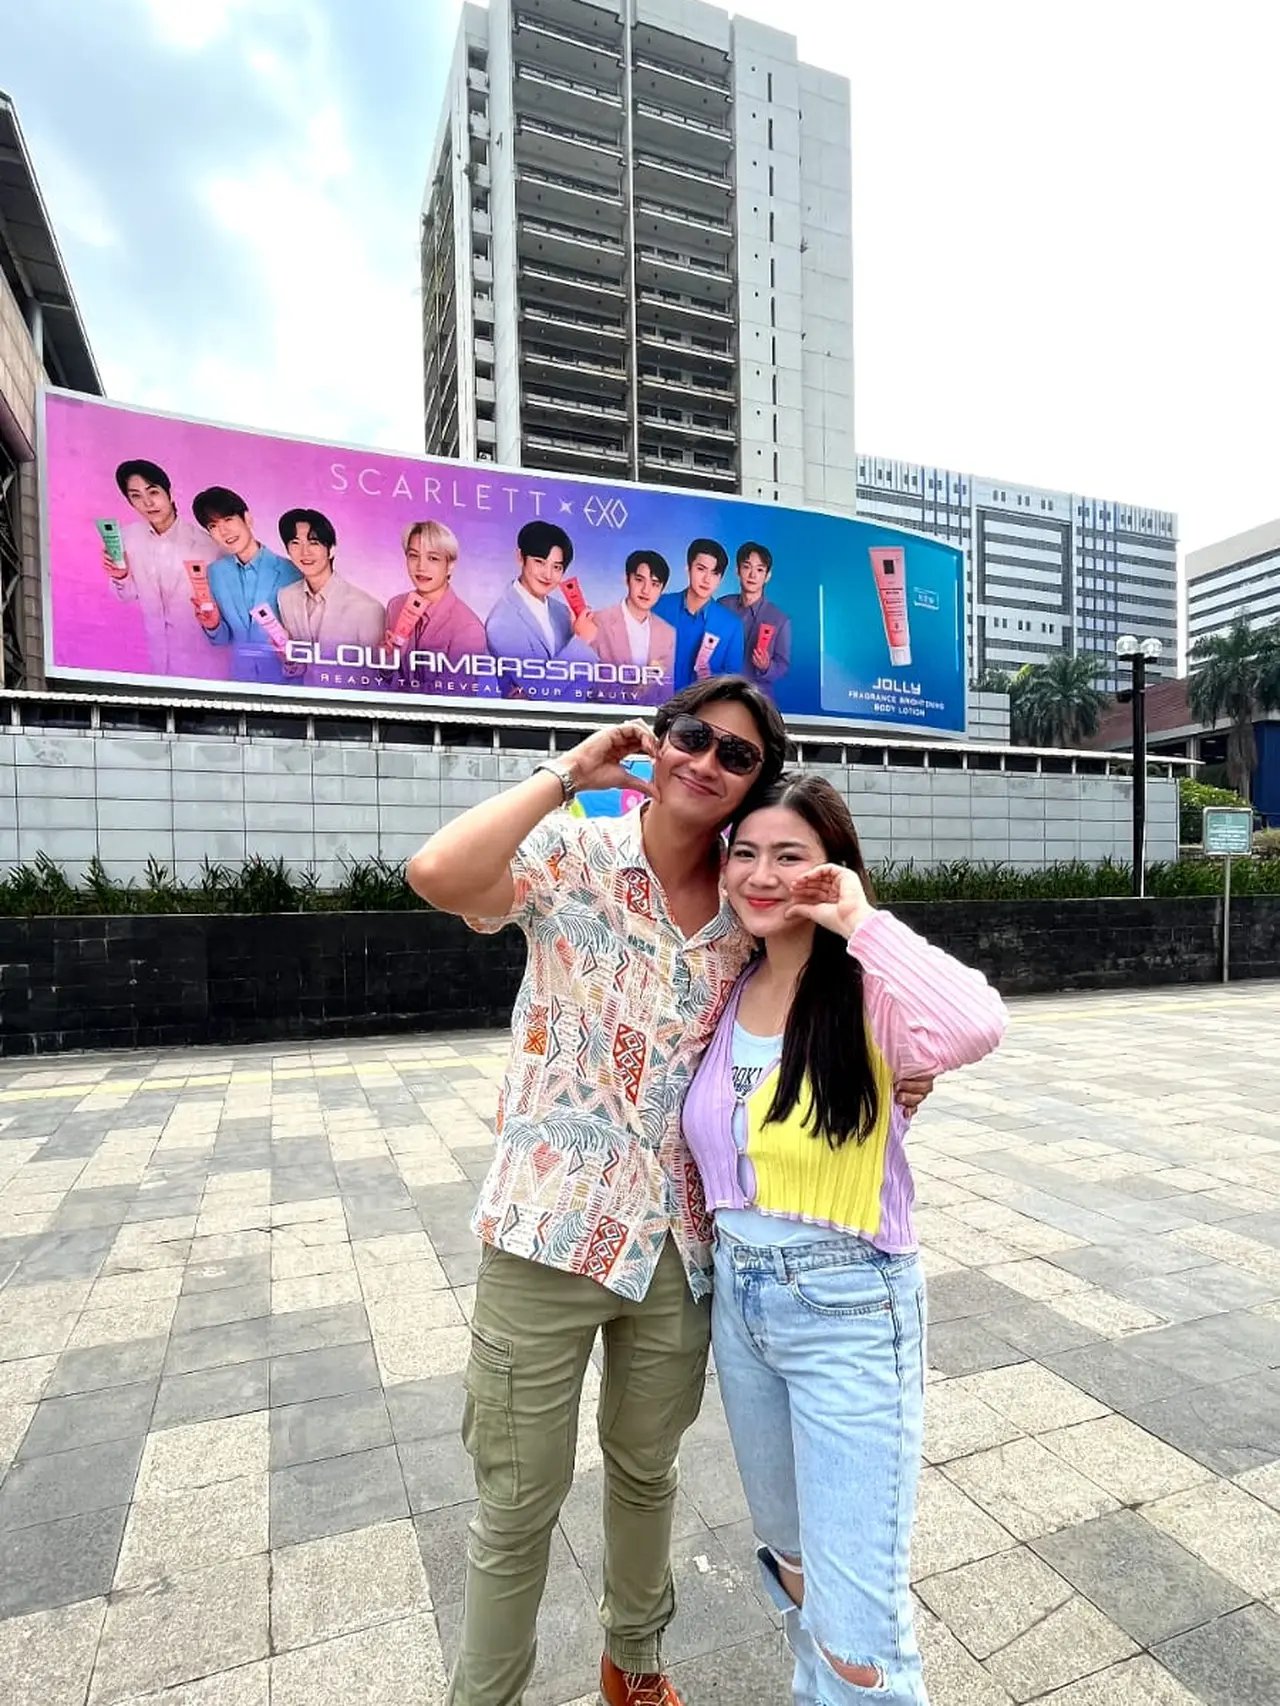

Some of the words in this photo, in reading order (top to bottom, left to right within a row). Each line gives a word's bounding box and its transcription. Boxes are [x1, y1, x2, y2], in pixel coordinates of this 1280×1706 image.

[330, 463, 547, 516] SCARLETT
[584, 495, 628, 529] EXO
[285, 640, 400, 669] GLOW
[410, 650, 664, 686] AMBASSADOR
[320, 673, 383, 686] READY
[398, 678, 420, 688] TO
[434, 680, 502, 693] REVEAL
[517, 685, 562, 696] YOUR
[575, 689, 638, 699] BEAUTY
[872, 677, 921, 695] JOLLY
[873, 703, 896, 713] BODY
